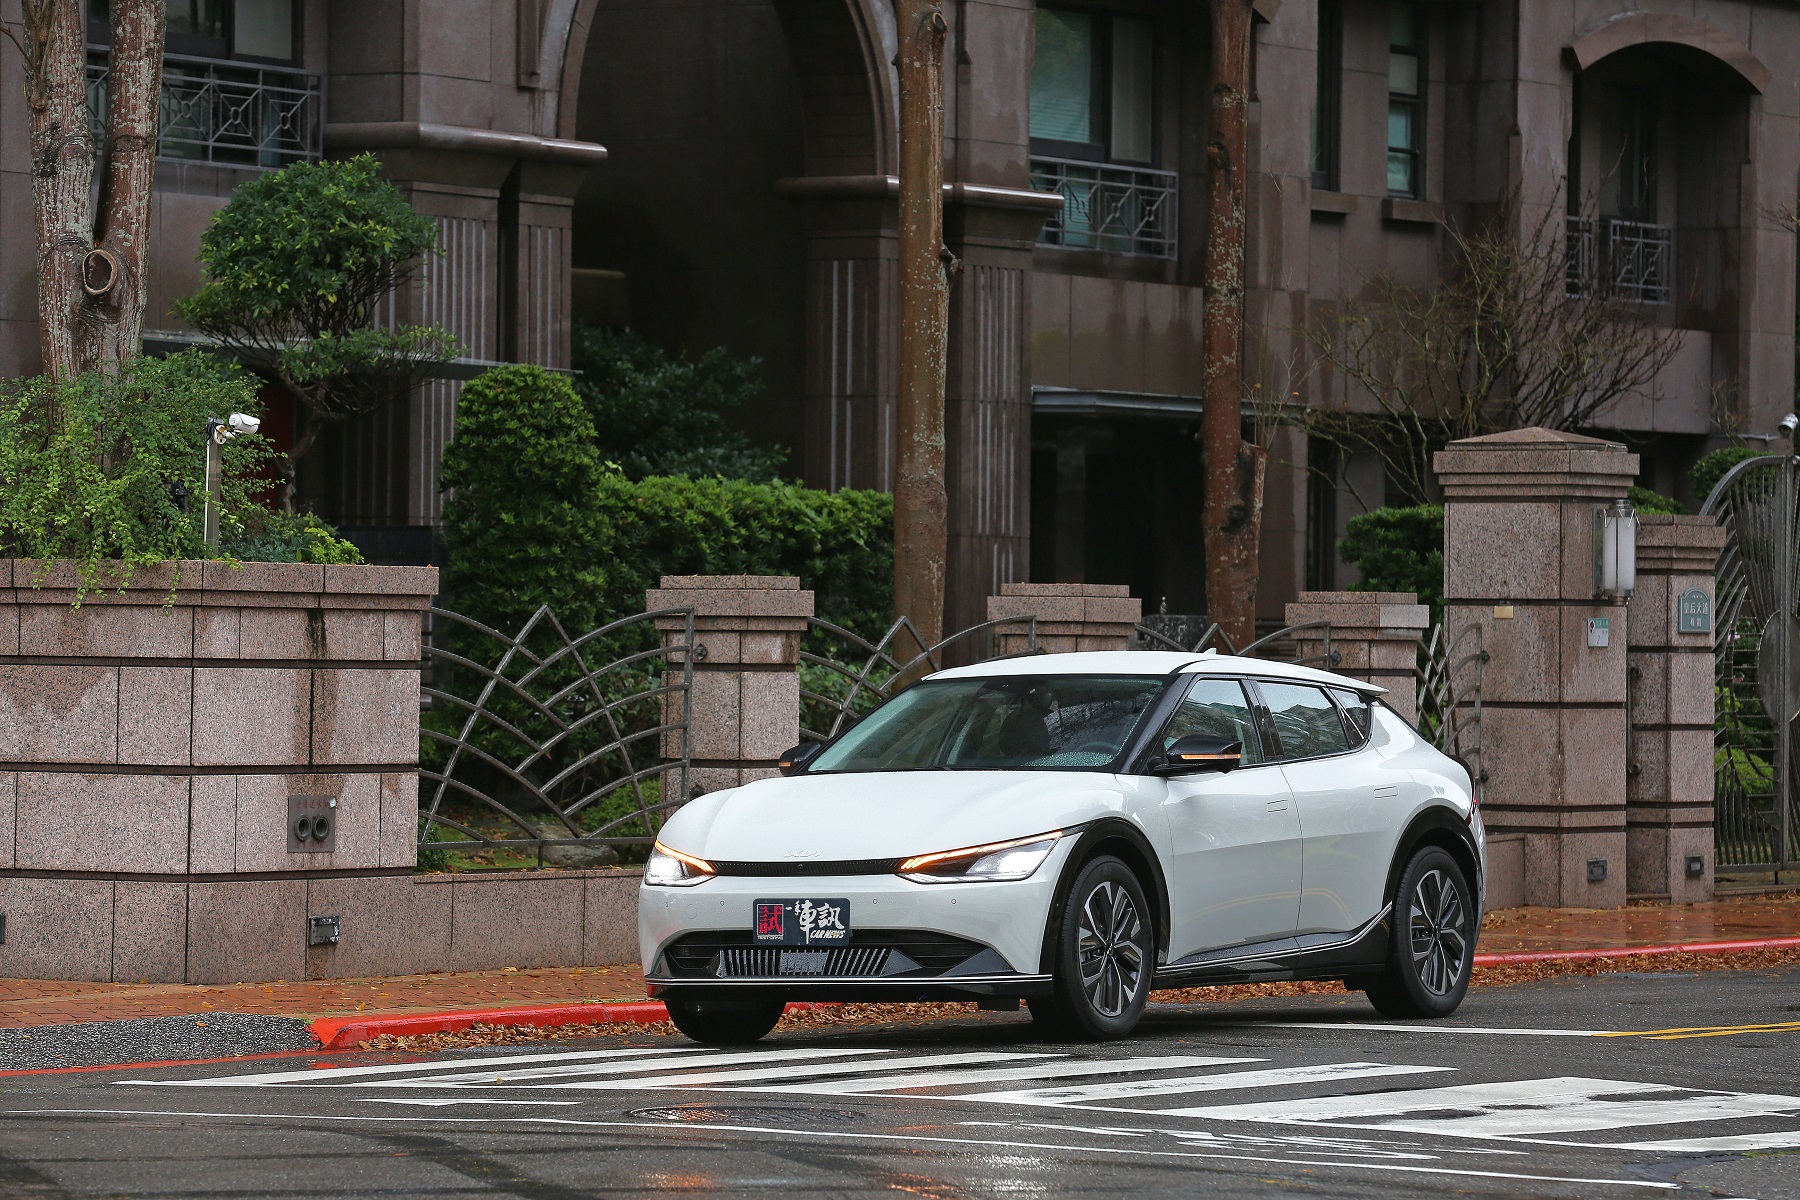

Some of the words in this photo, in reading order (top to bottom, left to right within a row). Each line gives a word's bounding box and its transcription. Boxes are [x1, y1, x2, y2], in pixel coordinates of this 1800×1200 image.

[758, 905, 783, 935] 試
[809, 930, 825, 939] CAR
[825, 930, 846, 939] NEWS
